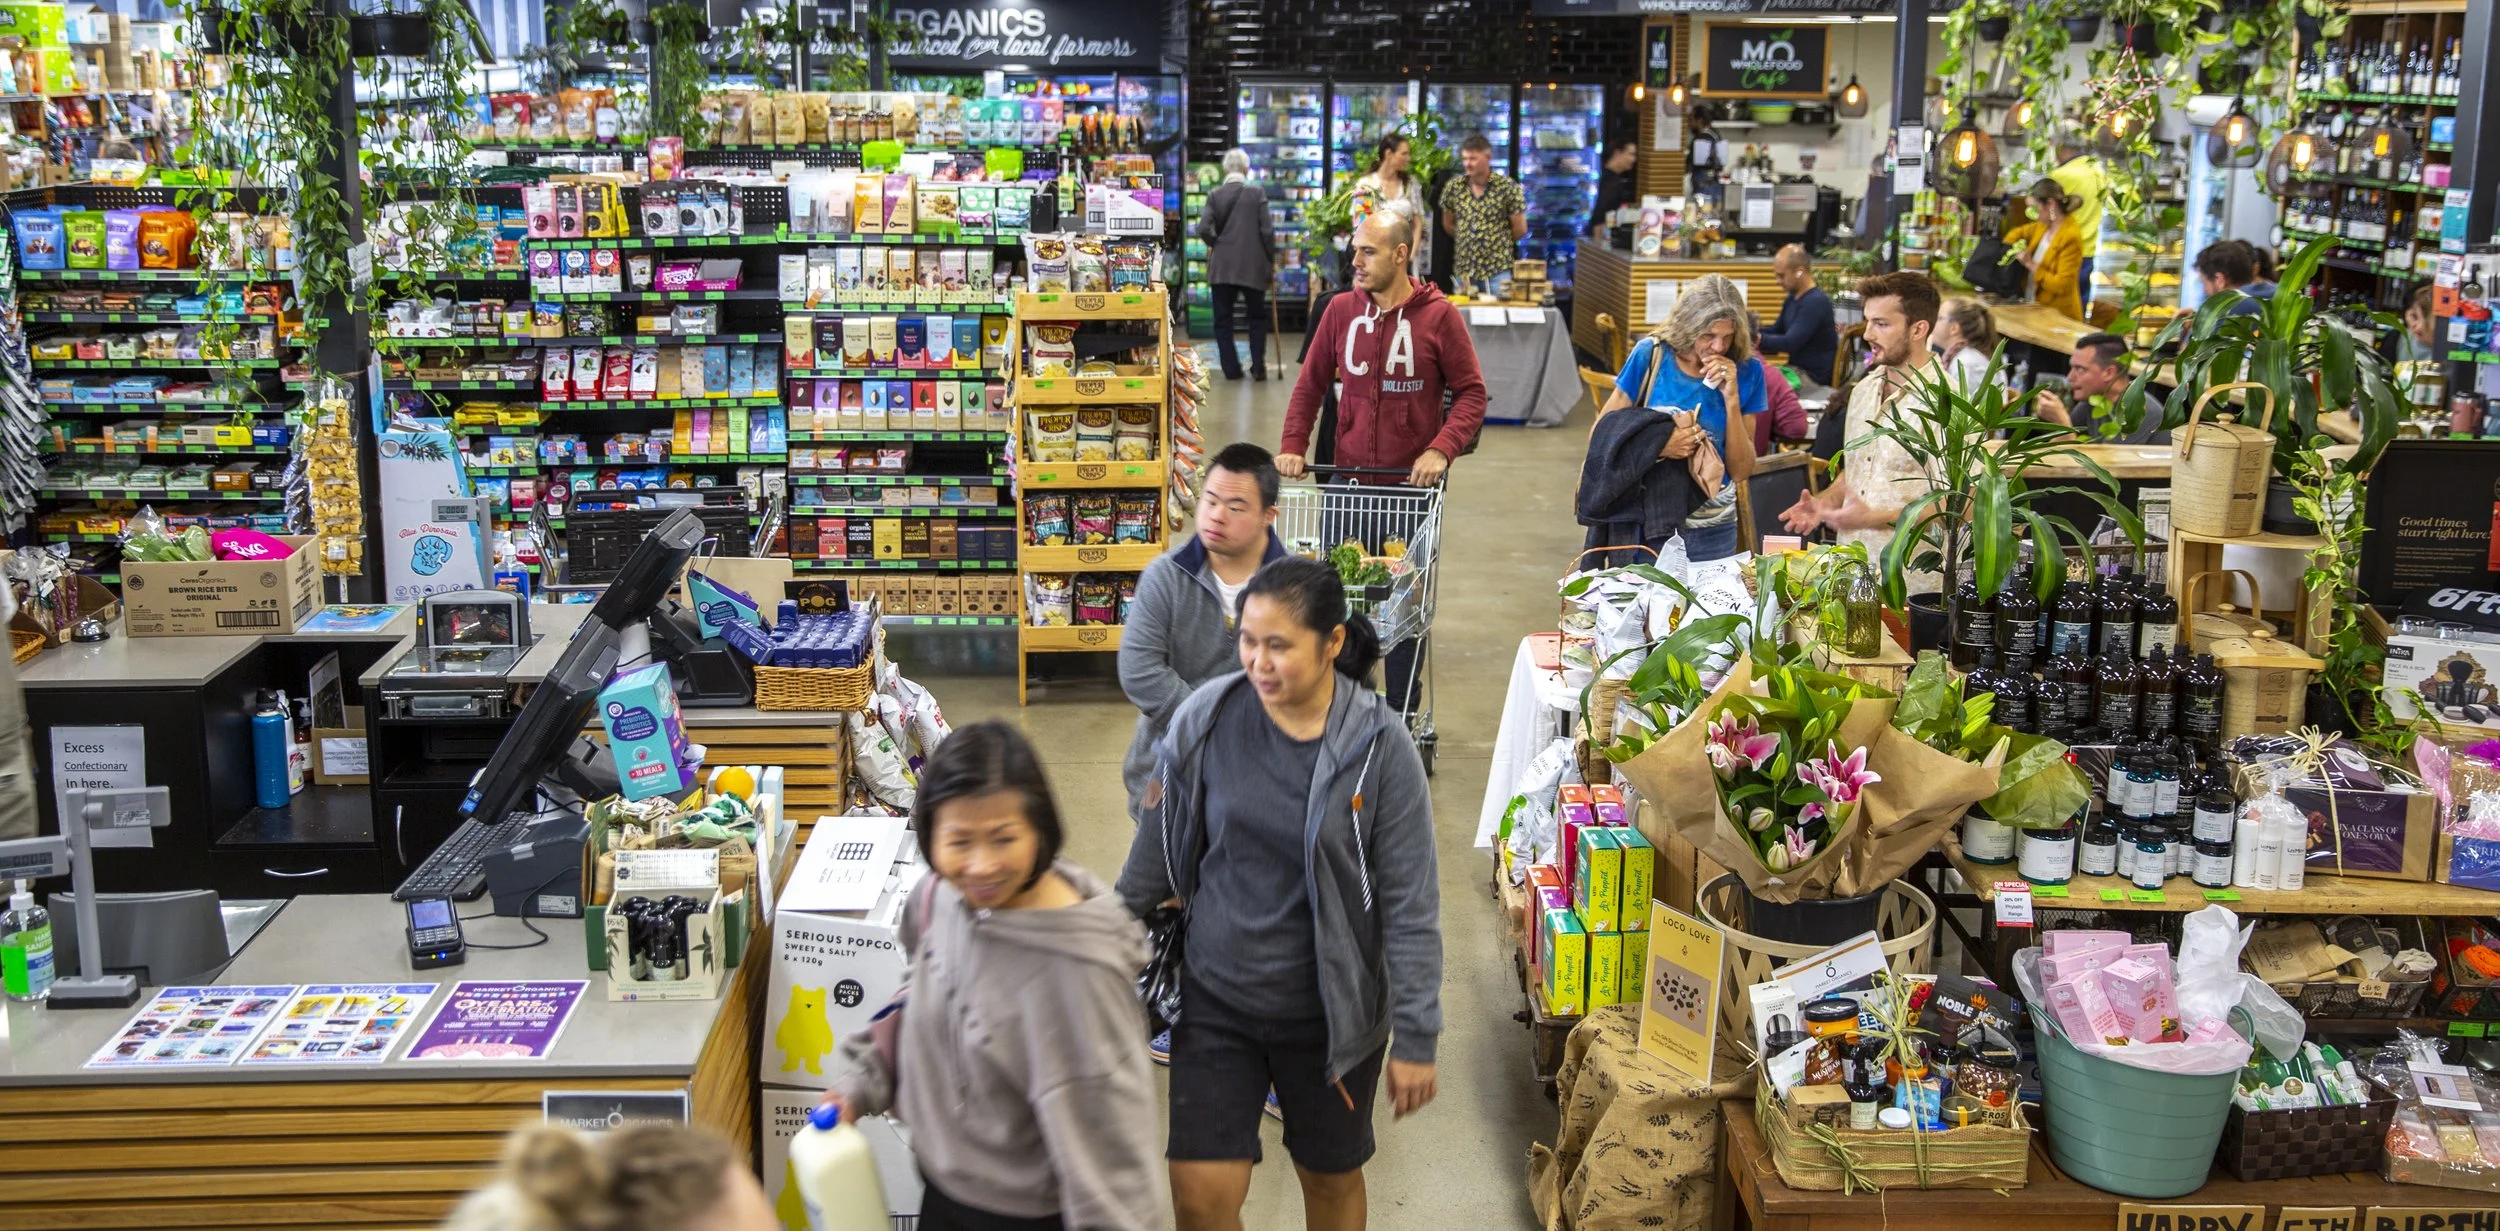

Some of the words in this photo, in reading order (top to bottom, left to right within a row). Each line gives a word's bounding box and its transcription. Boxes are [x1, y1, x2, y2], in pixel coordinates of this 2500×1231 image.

[893, 7, 1047, 38] RGANICS
[1730, 59, 1803, 71] WHOLEFOOD
[1382, 379, 1424, 393] HOLLISTER
[1040, 416, 1071, 425] PROPER
[2399, 516, 2433, 527] Good
[2434, 517, 2468, 528] times
[399, 528, 417, 539] Blue
[420, 523, 459, 538] Dinosaur
[2397, 528, 2427, 538] start
[2429, 528, 2459, 540] right
[168, 586, 196, 594] BROWN
[800, 595, 837, 607] POG
[2427, 587, 2500, 615] 6Ft
[619, 714, 650, 726] PREBIOTICS
[620, 720, 652, 732] PROBIOTICS
[64, 742, 104, 753] Excess
[64, 761, 128, 771] Confectionary
[643, 765, 663, 775] MEALS
[66, 778, 78, 788] In
[81, 778, 114, 788] here.
[2338, 823, 2348, 831] IN
[2356, 824, 2386, 833] CLASS
[2386, 826, 2399, 834] OF
[1663, 916, 1686, 932] LOCO
[1689, 927, 1711, 944] LOVE
[786, 929, 842, 944] SERIOUS
[785, 942, 815, 953] SWEET
[819, 946, 825, 954] &
[829, 947, 857, 957] SALTY
[784, 953, 789, 961] 8
[802, 956, 823, 966] 120g
[475, 1000, 541, 1008] YEARS
[840, 995, 854, 1004] x8
[468, 1006, 558, 1014] CELEBRATION
[1936, 995, 1974, 1018] NOBLE
[775, 1106, 813, 1115] SERIO
[560, 1118, 607, 1129] MARKET
